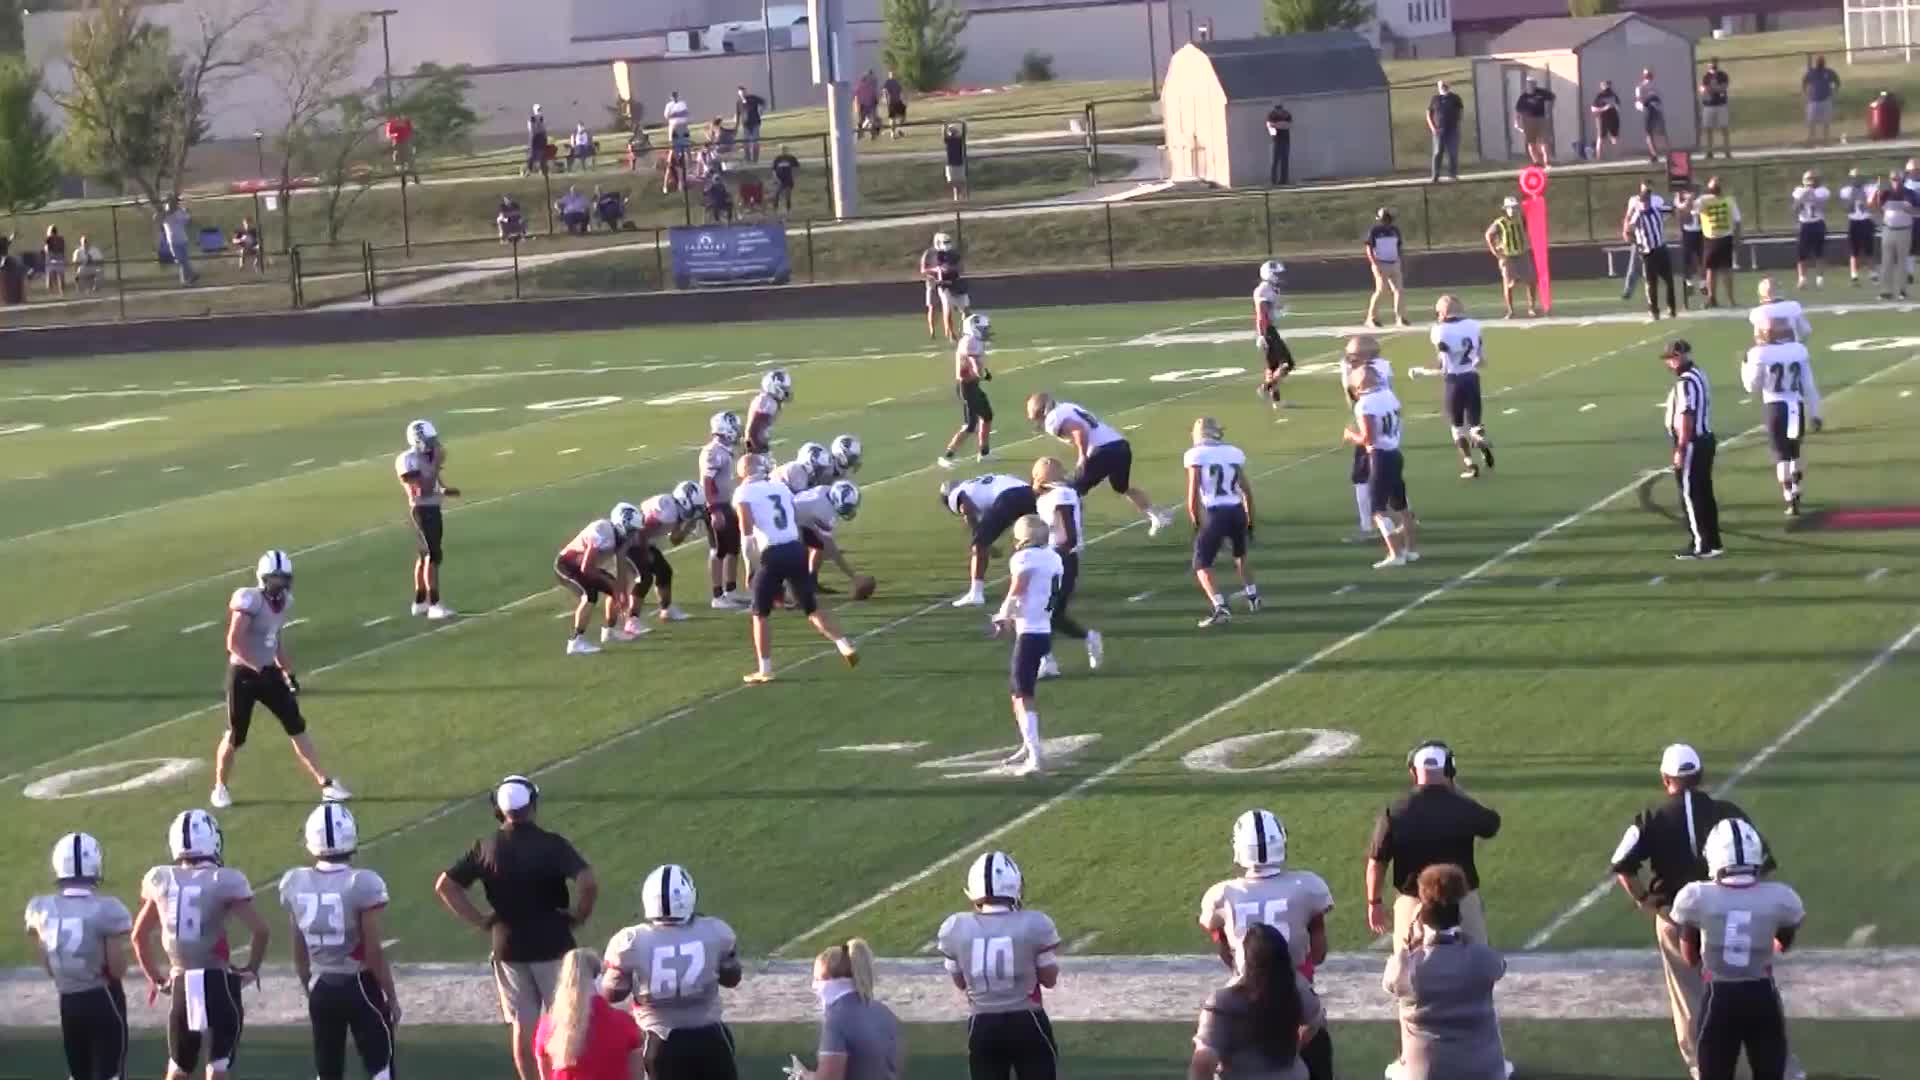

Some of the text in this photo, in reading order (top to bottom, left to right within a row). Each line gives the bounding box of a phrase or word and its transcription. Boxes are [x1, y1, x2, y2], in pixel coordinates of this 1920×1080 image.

[1769, 361, 1801, 393] 22
[766, 494, 788, 531] 3
[970, 935, 1015, 991] 10
